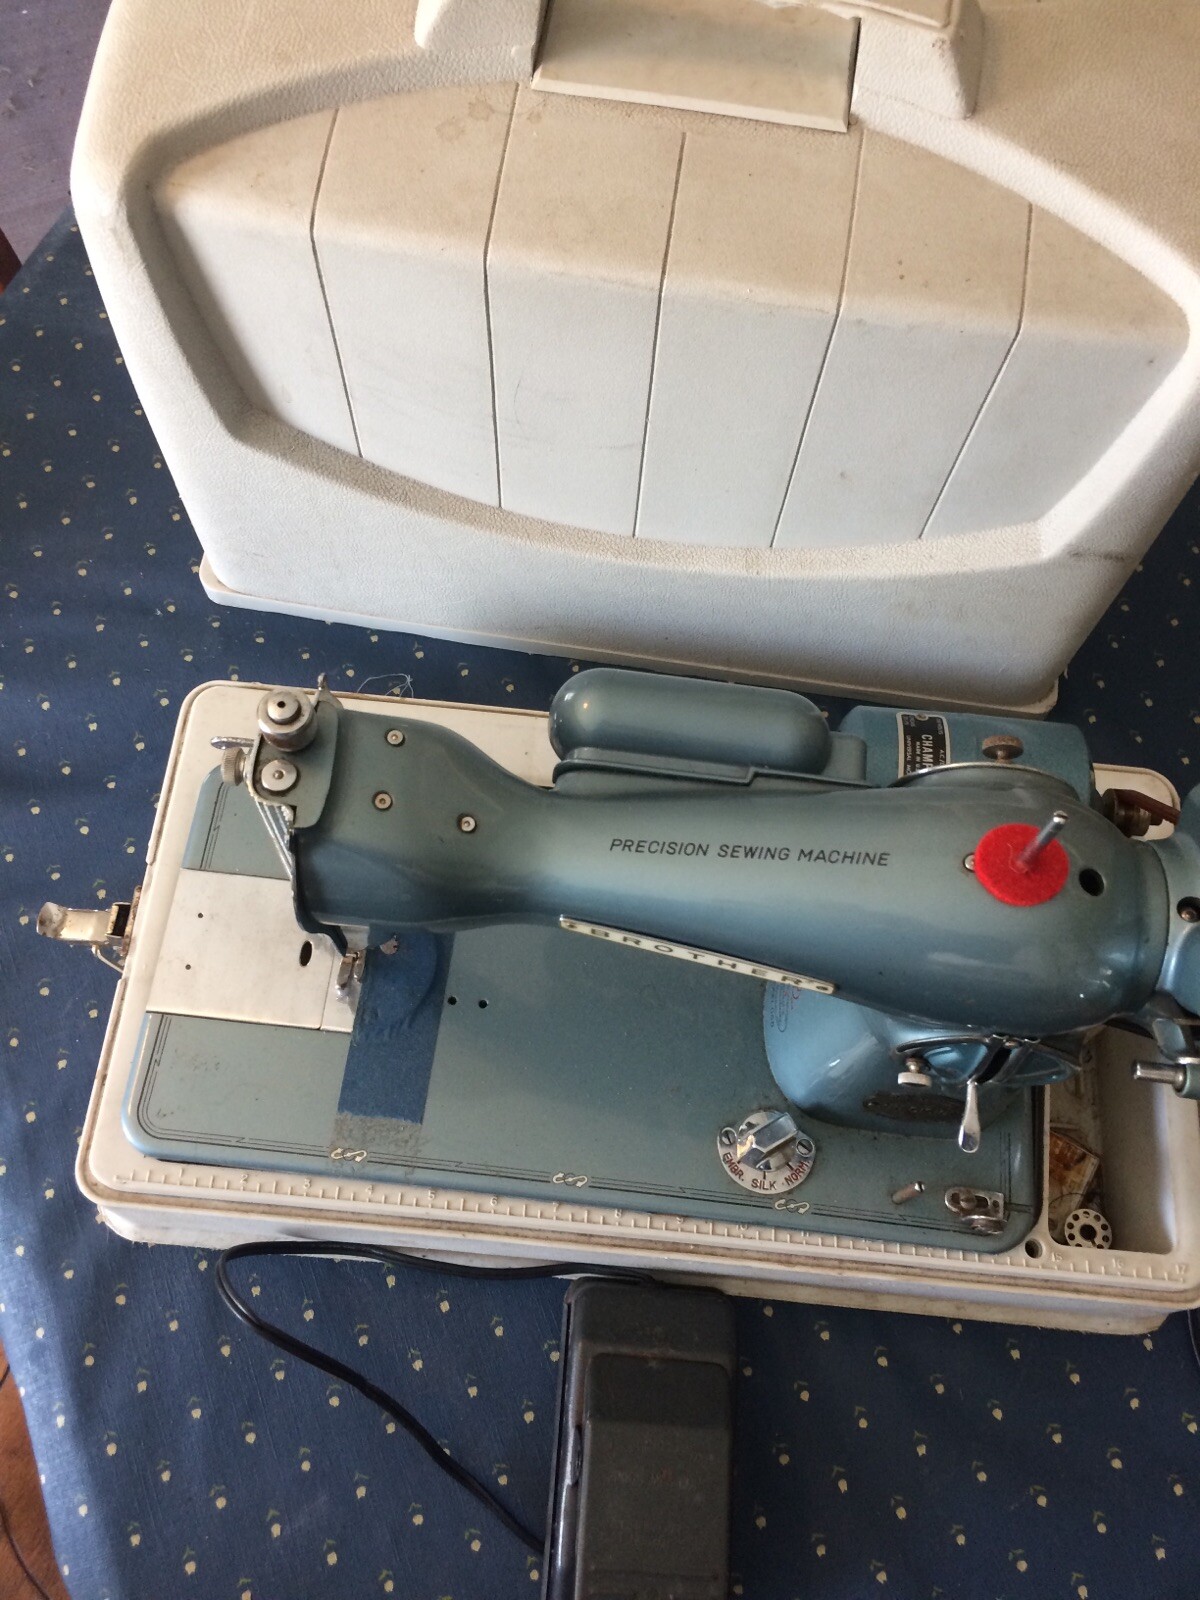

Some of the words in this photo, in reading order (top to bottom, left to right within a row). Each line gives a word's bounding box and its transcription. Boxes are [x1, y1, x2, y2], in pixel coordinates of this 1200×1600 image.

[609, 838, 710, 856] PRECISION
[717, 844, 790, 861] SEWING
[797, 848, 891, 867] MACHINE
[590, 928, 803, 985] BROTHER
[722, 1152, 744, 1182] EMBR.
[751, 1178, 777, 1191] SILK
[240, 1173, 249, 1184] 2
[303, 1178, 312, 1189] 3
[365, 1184, 374, 1195] 4
[427, 1189, 436, 1201] 5
[490, 1195, 499, 1207] 6
